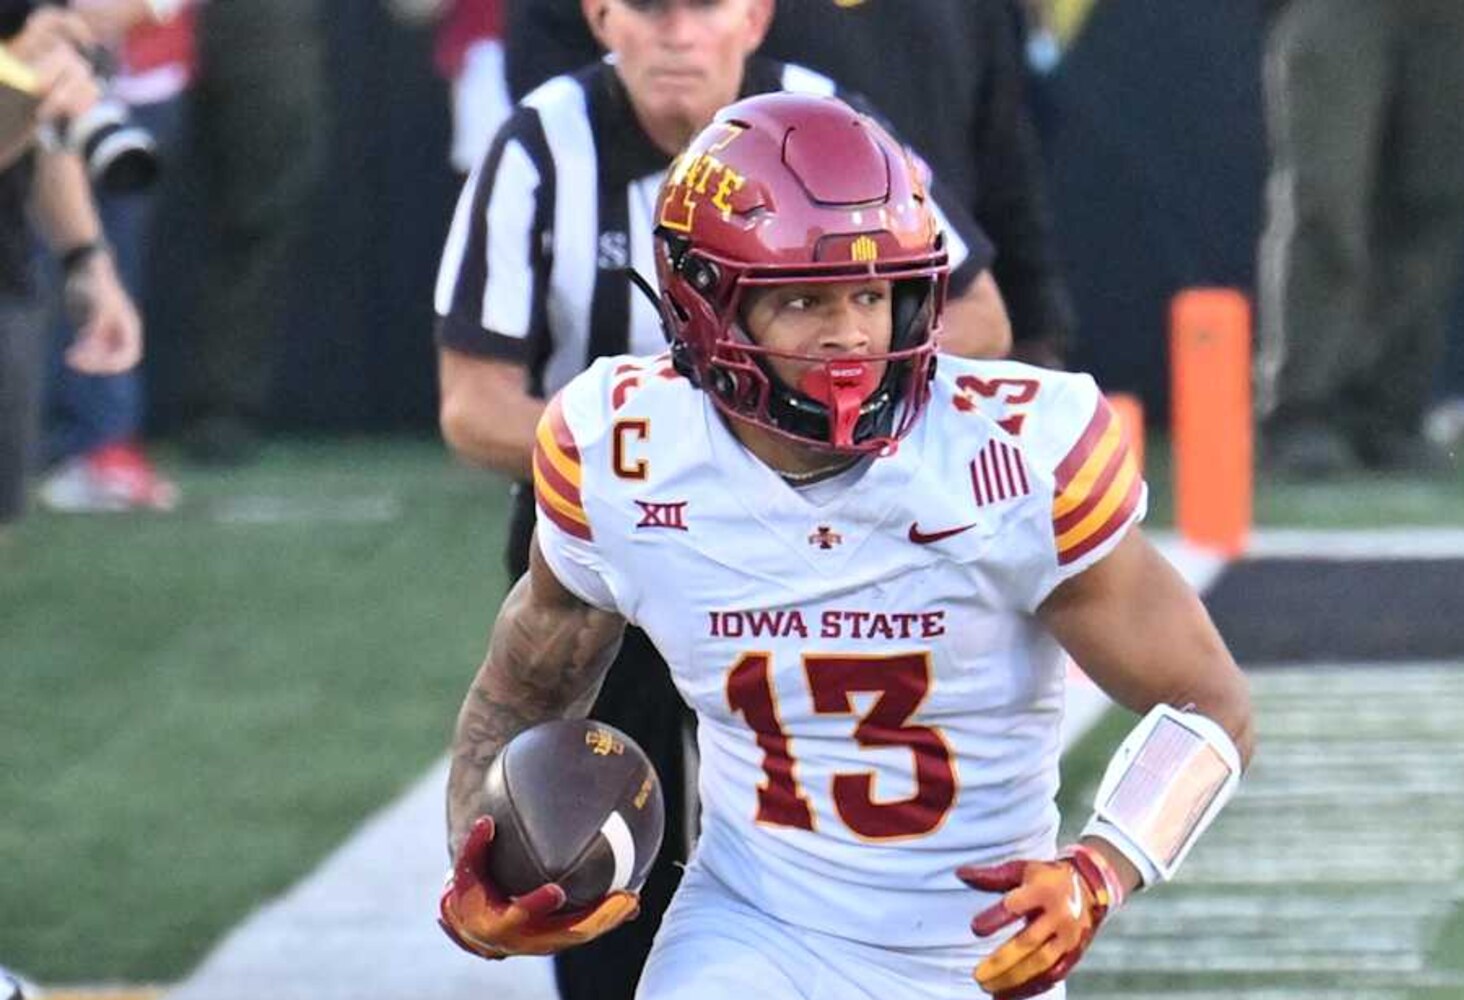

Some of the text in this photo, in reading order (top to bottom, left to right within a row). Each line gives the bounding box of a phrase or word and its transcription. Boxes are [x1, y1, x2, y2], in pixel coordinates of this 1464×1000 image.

[611, 416, 651, 482] C
[633, 499, 689, 532] XII
[709, 611, 945, 638] IOWA STATE
[725, 650, 958, 844] 13
